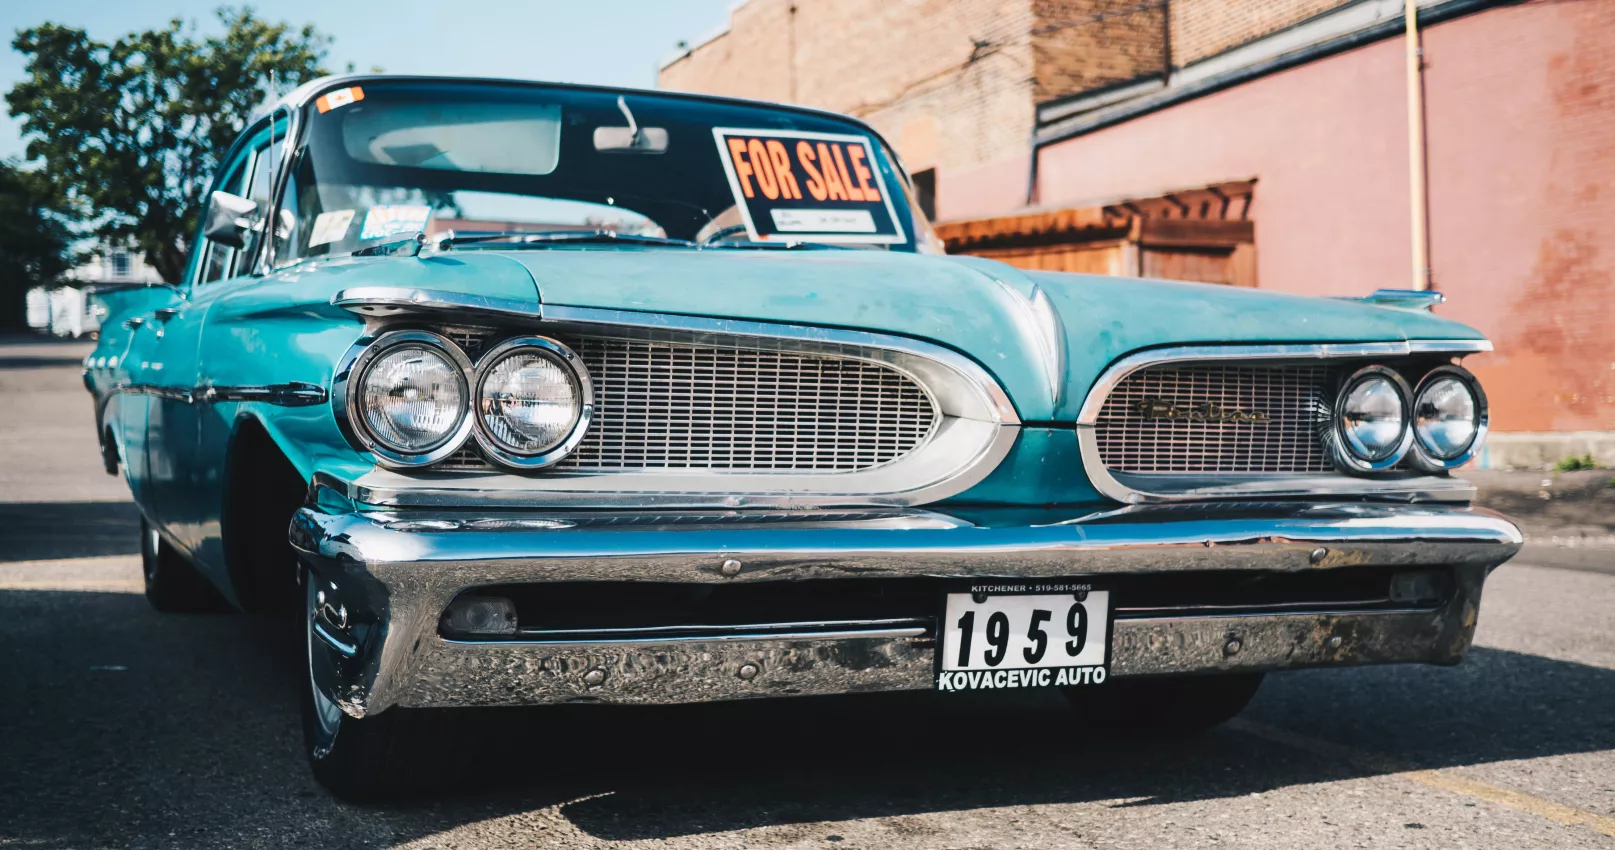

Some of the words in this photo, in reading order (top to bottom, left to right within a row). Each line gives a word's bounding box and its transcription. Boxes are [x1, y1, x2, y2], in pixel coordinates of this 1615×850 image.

[727, 138, 802, 200] FOR
[796, 140, 881, 201] SALE
[1136, 399, 1271, 422] Pontiac
[971, 584, 1026, 592] KITCHENER
[1035, 583, 1092, 591] 519-581-5665
[957, 602, 1088, 667] 1959
[938, 669, 1051, 690] KOVACEVIC
[1055, 666, 1106, 686] AUTO
